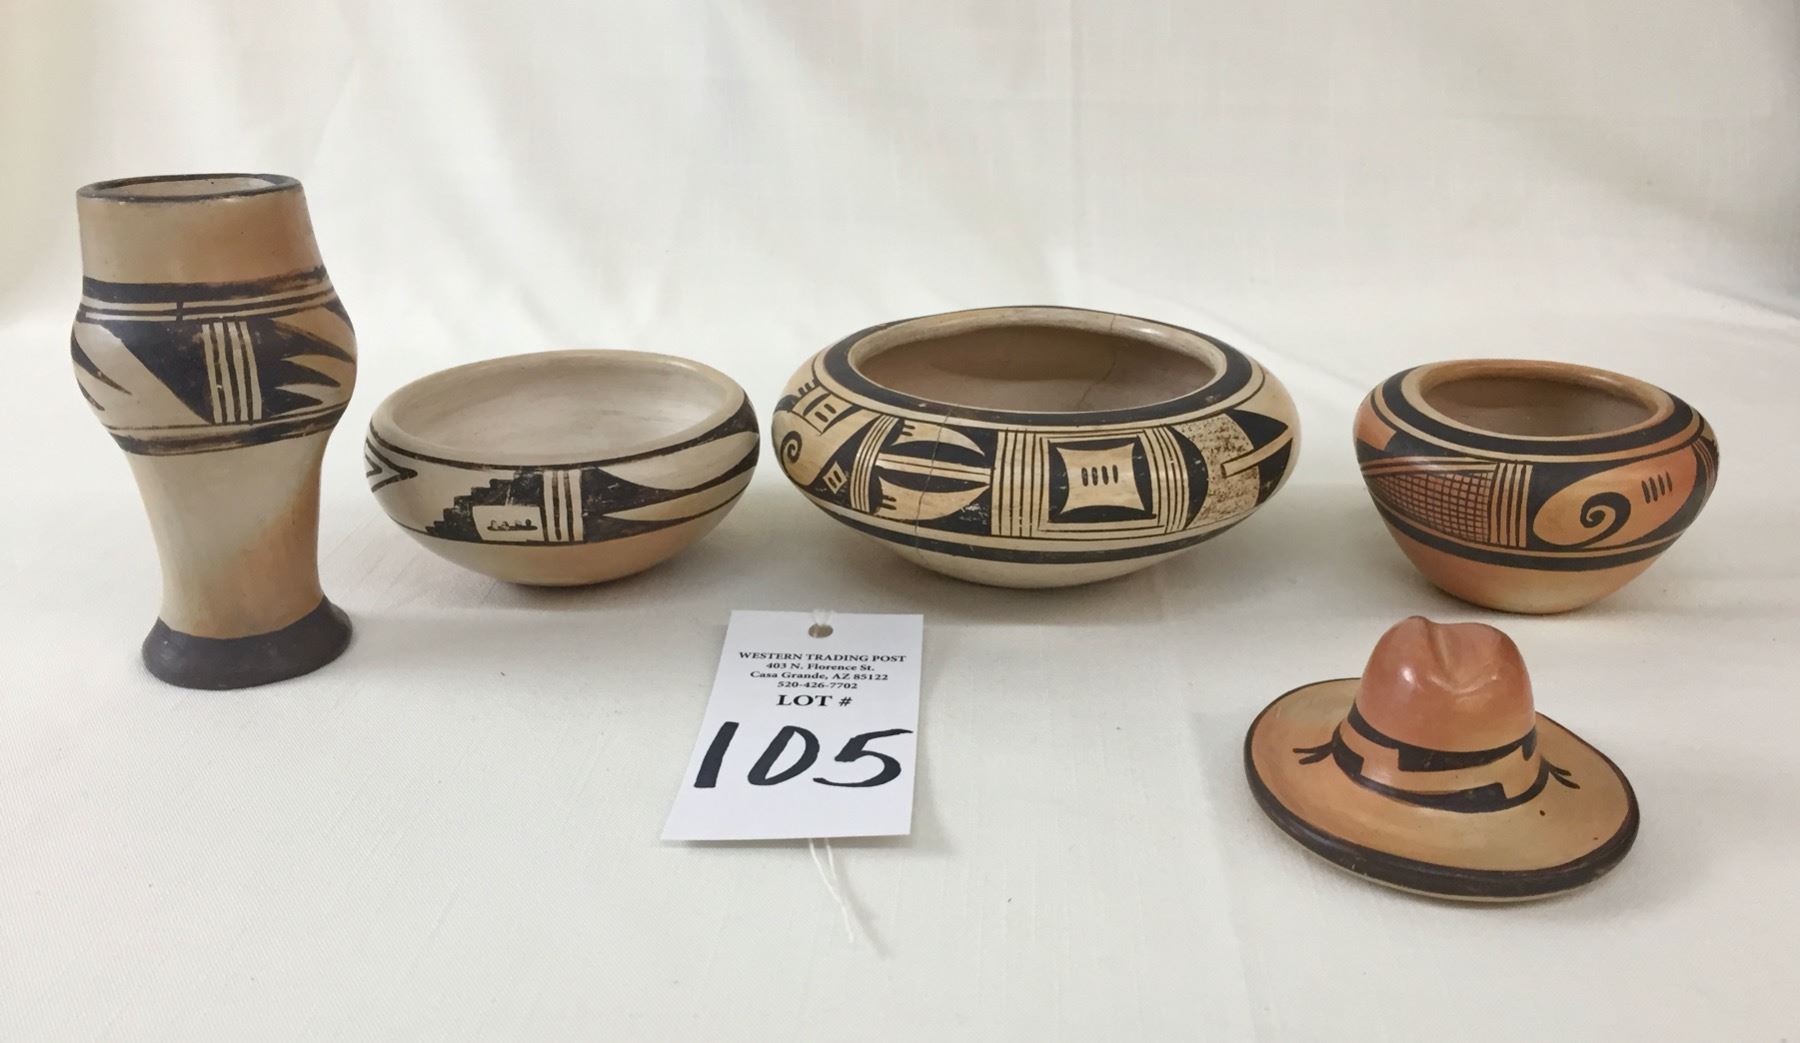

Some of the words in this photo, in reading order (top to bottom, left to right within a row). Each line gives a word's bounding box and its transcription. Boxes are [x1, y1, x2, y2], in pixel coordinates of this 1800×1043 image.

[739, 651, 802, 660] WESTERN
[806, 653, 869, 662] TRADING
[807, 663, 857, 671] Florence
[781, 672, 829, 680] Grande,
[777, 681, 858, 689] 520-426-7702
[776, 694, 833, 707] LOT
[839, 696, 852, 707] #
[694, 721, 914, 788] 105
